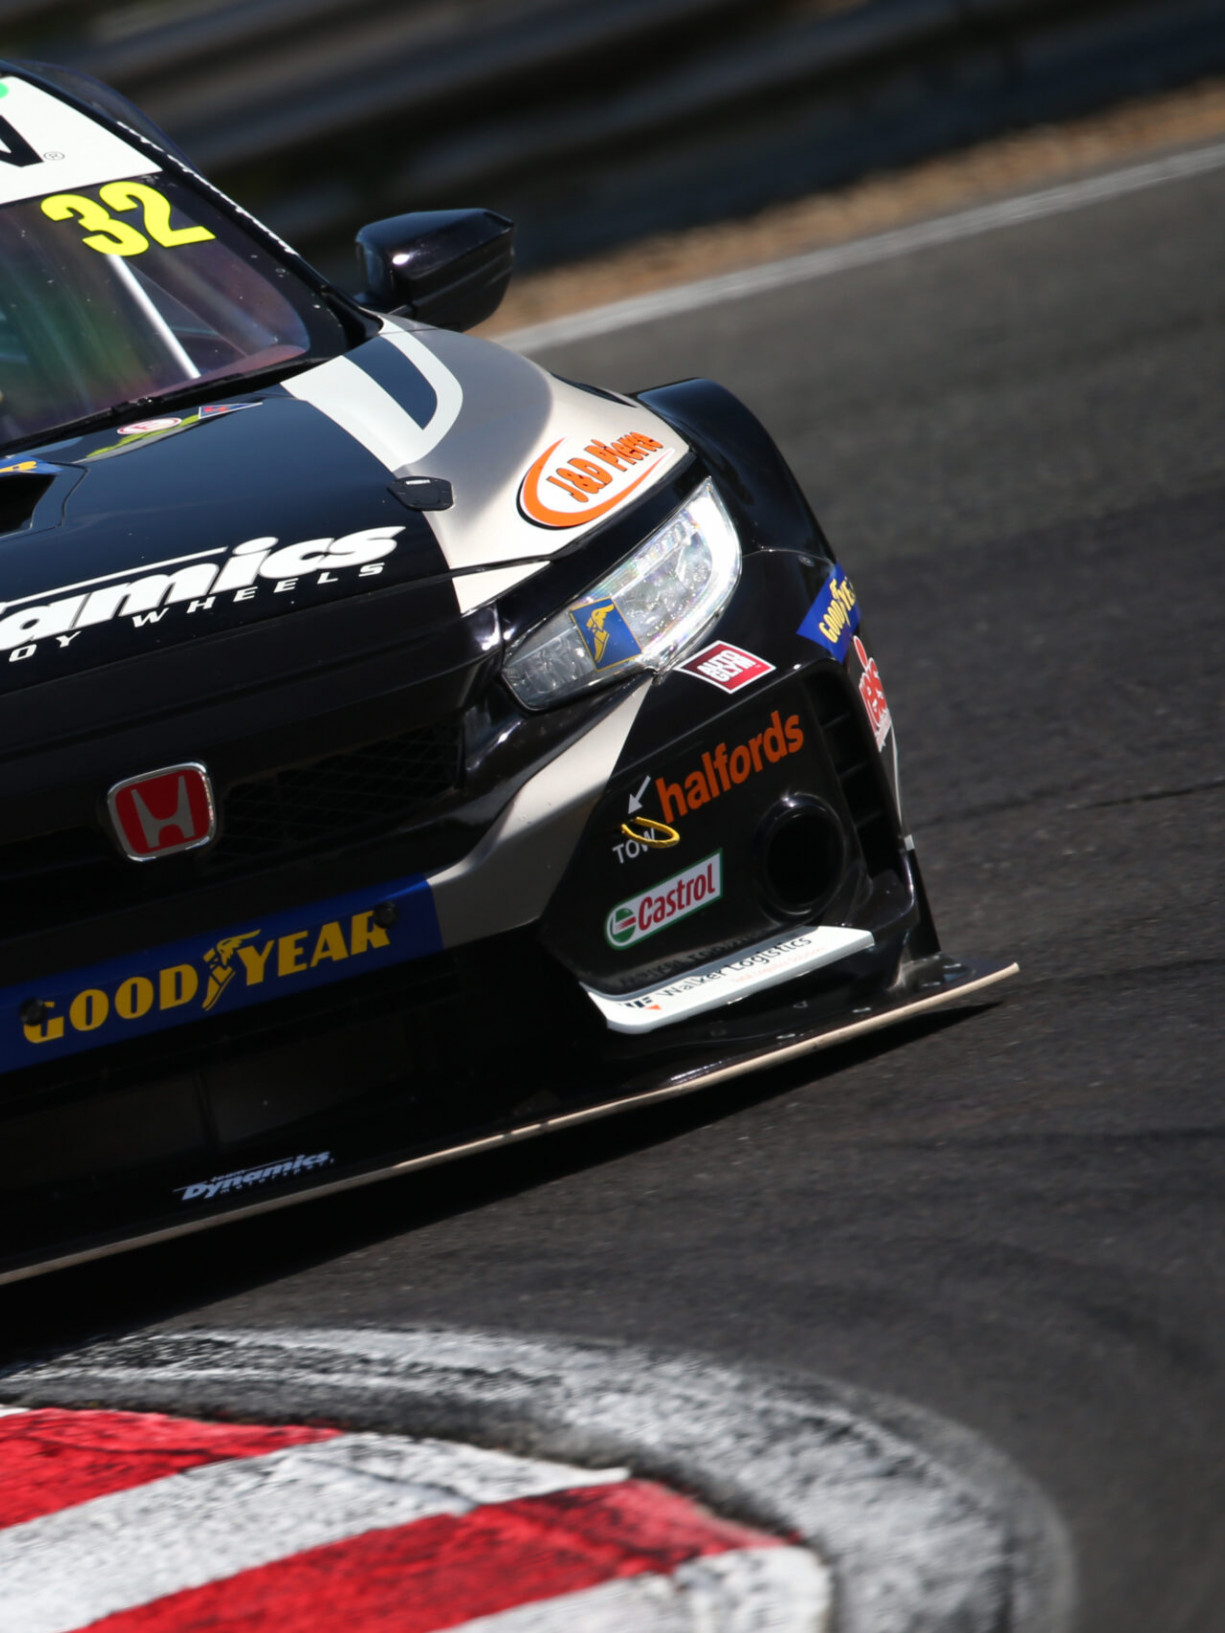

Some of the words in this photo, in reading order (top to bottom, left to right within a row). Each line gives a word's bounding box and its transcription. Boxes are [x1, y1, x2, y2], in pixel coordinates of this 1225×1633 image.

[40, 181, 216, 257] 32
[546, 457, 614, 503] J&D
[584, 431, 664, 472] Pierce
[132, 562, 385, 628] WHEELS
[655, 710, 805, 823] halfords
[639, 863, 716, 931] Castrol
[662, 967, 727, 997] Walker
[723, 937, 813, 973] Logistics
[181, 1151, 331, 1201] Dynamics
